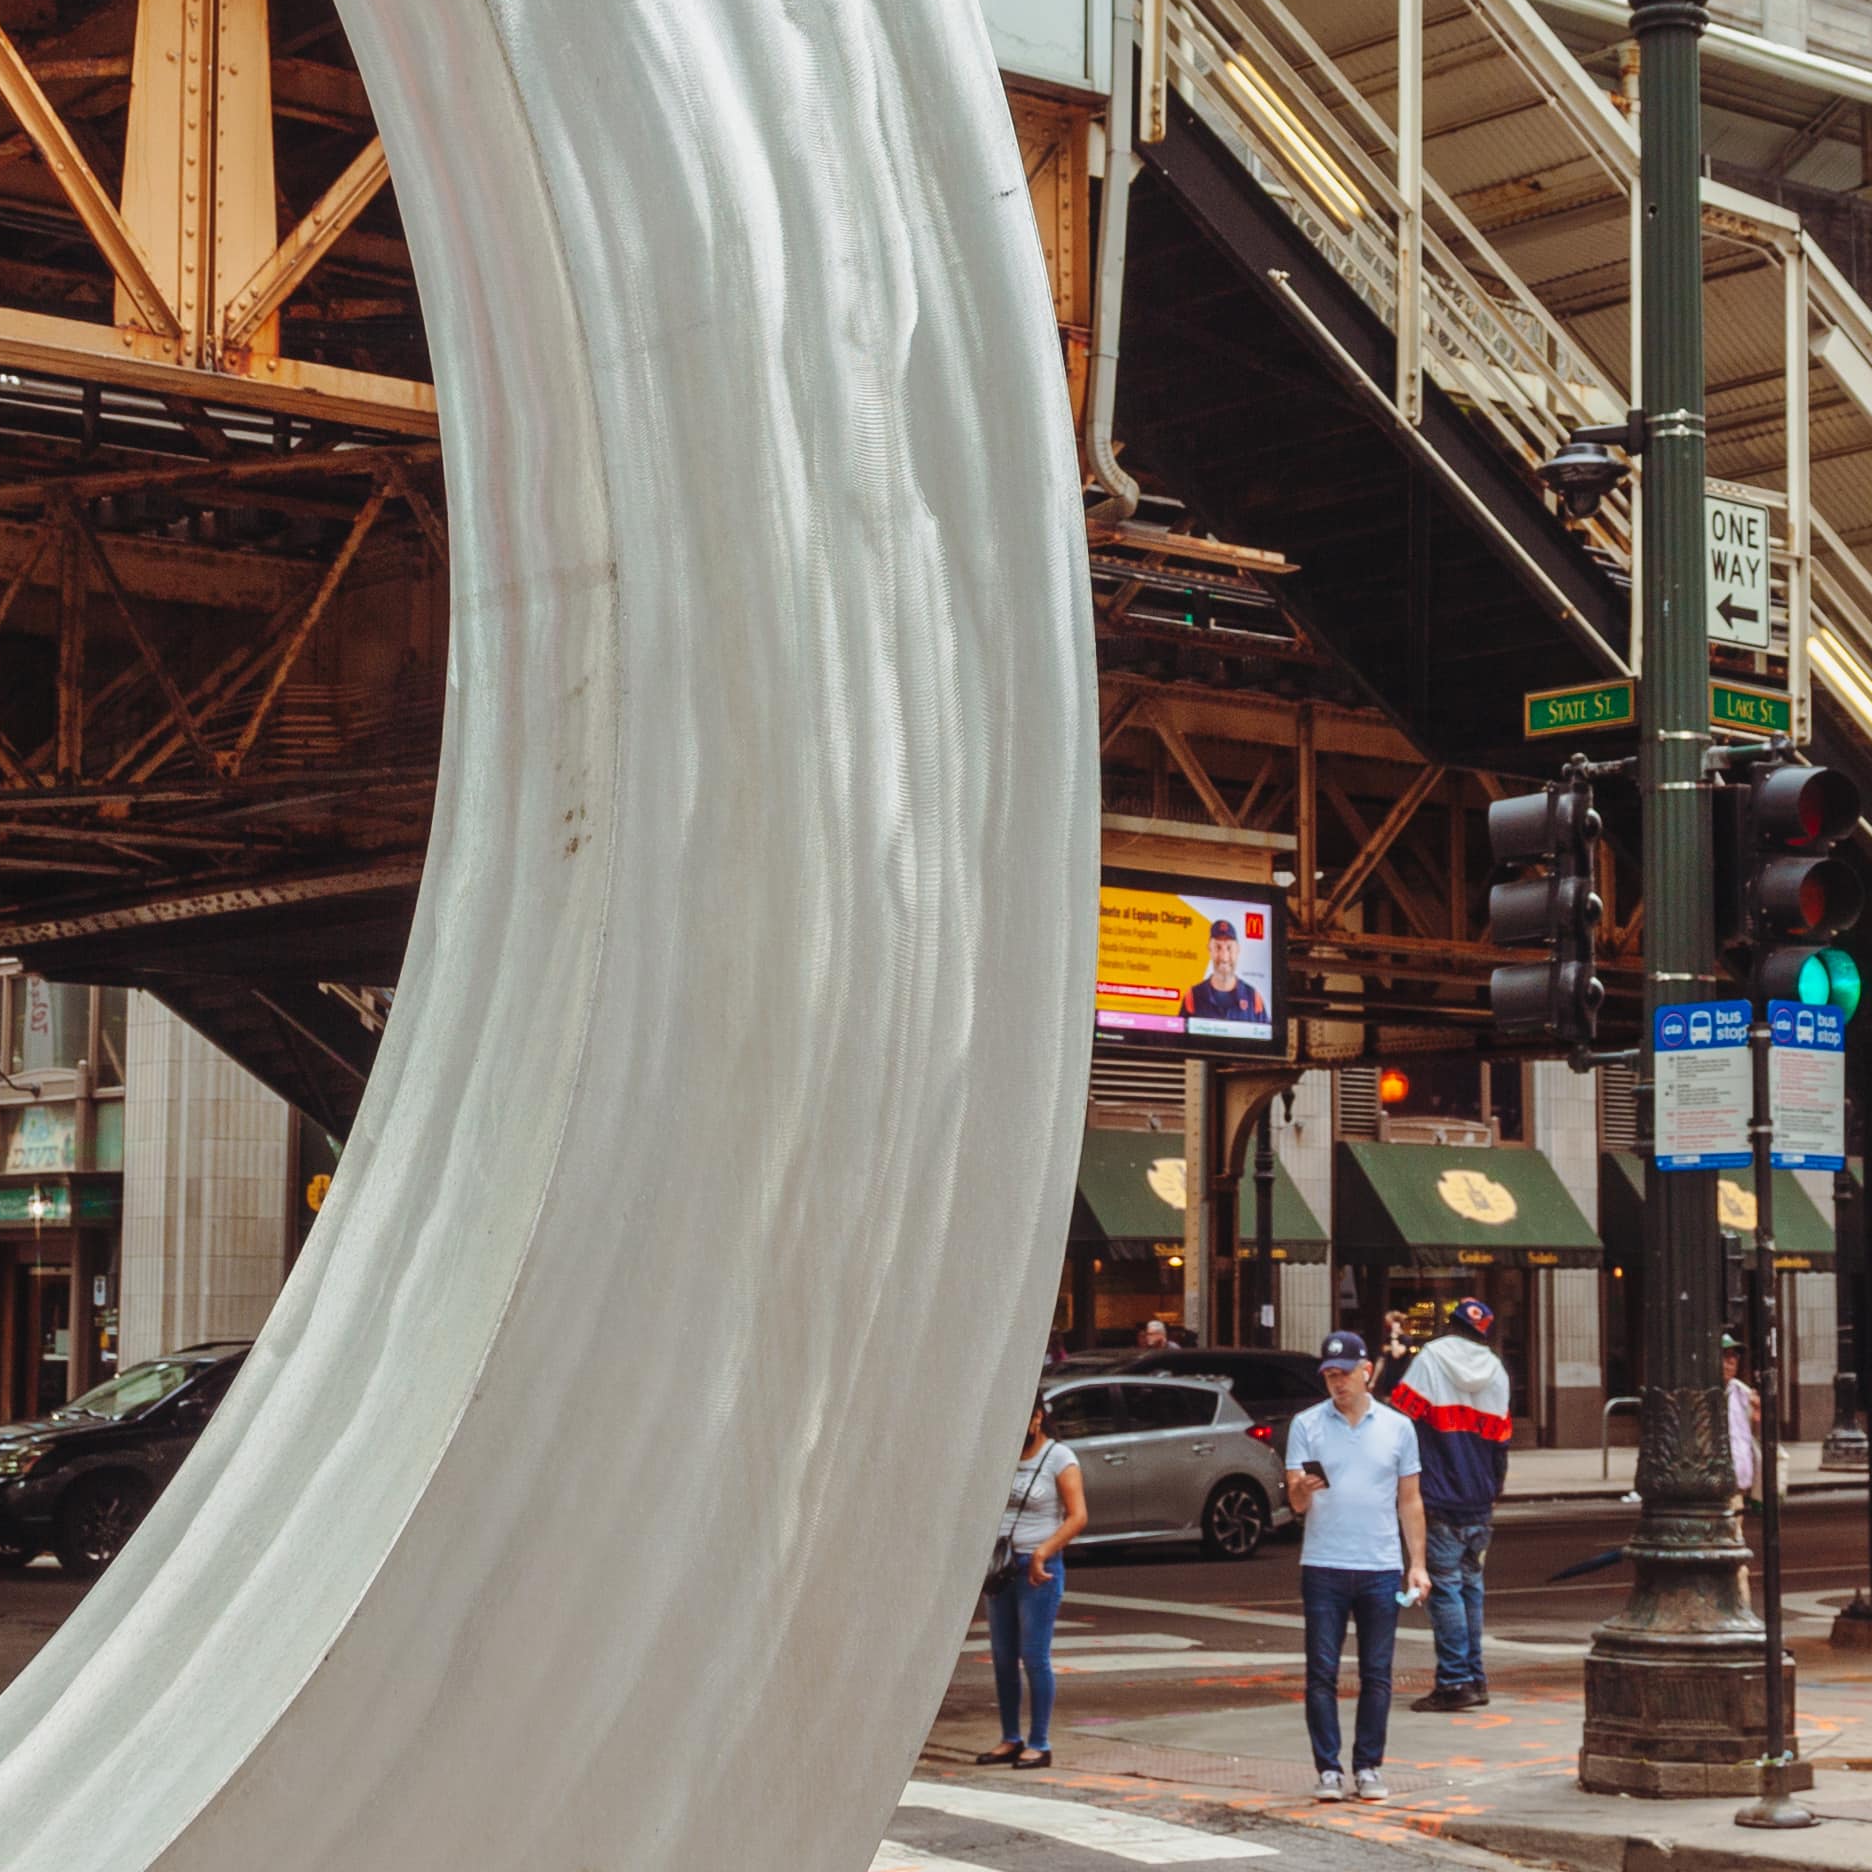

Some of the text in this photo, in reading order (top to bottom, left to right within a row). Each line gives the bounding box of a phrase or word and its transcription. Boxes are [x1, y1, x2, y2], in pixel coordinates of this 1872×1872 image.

[1712, 510, 1759, 549] ONE
[1711, 547, 1761, 588] WAY
[1716, 1009, 1742, 1025] bus
[1817, 1013, 1837, 1029] bus
[1716, 1024, 1749, 1044] stop
[1817, 1030, 1841, 1047] stop
